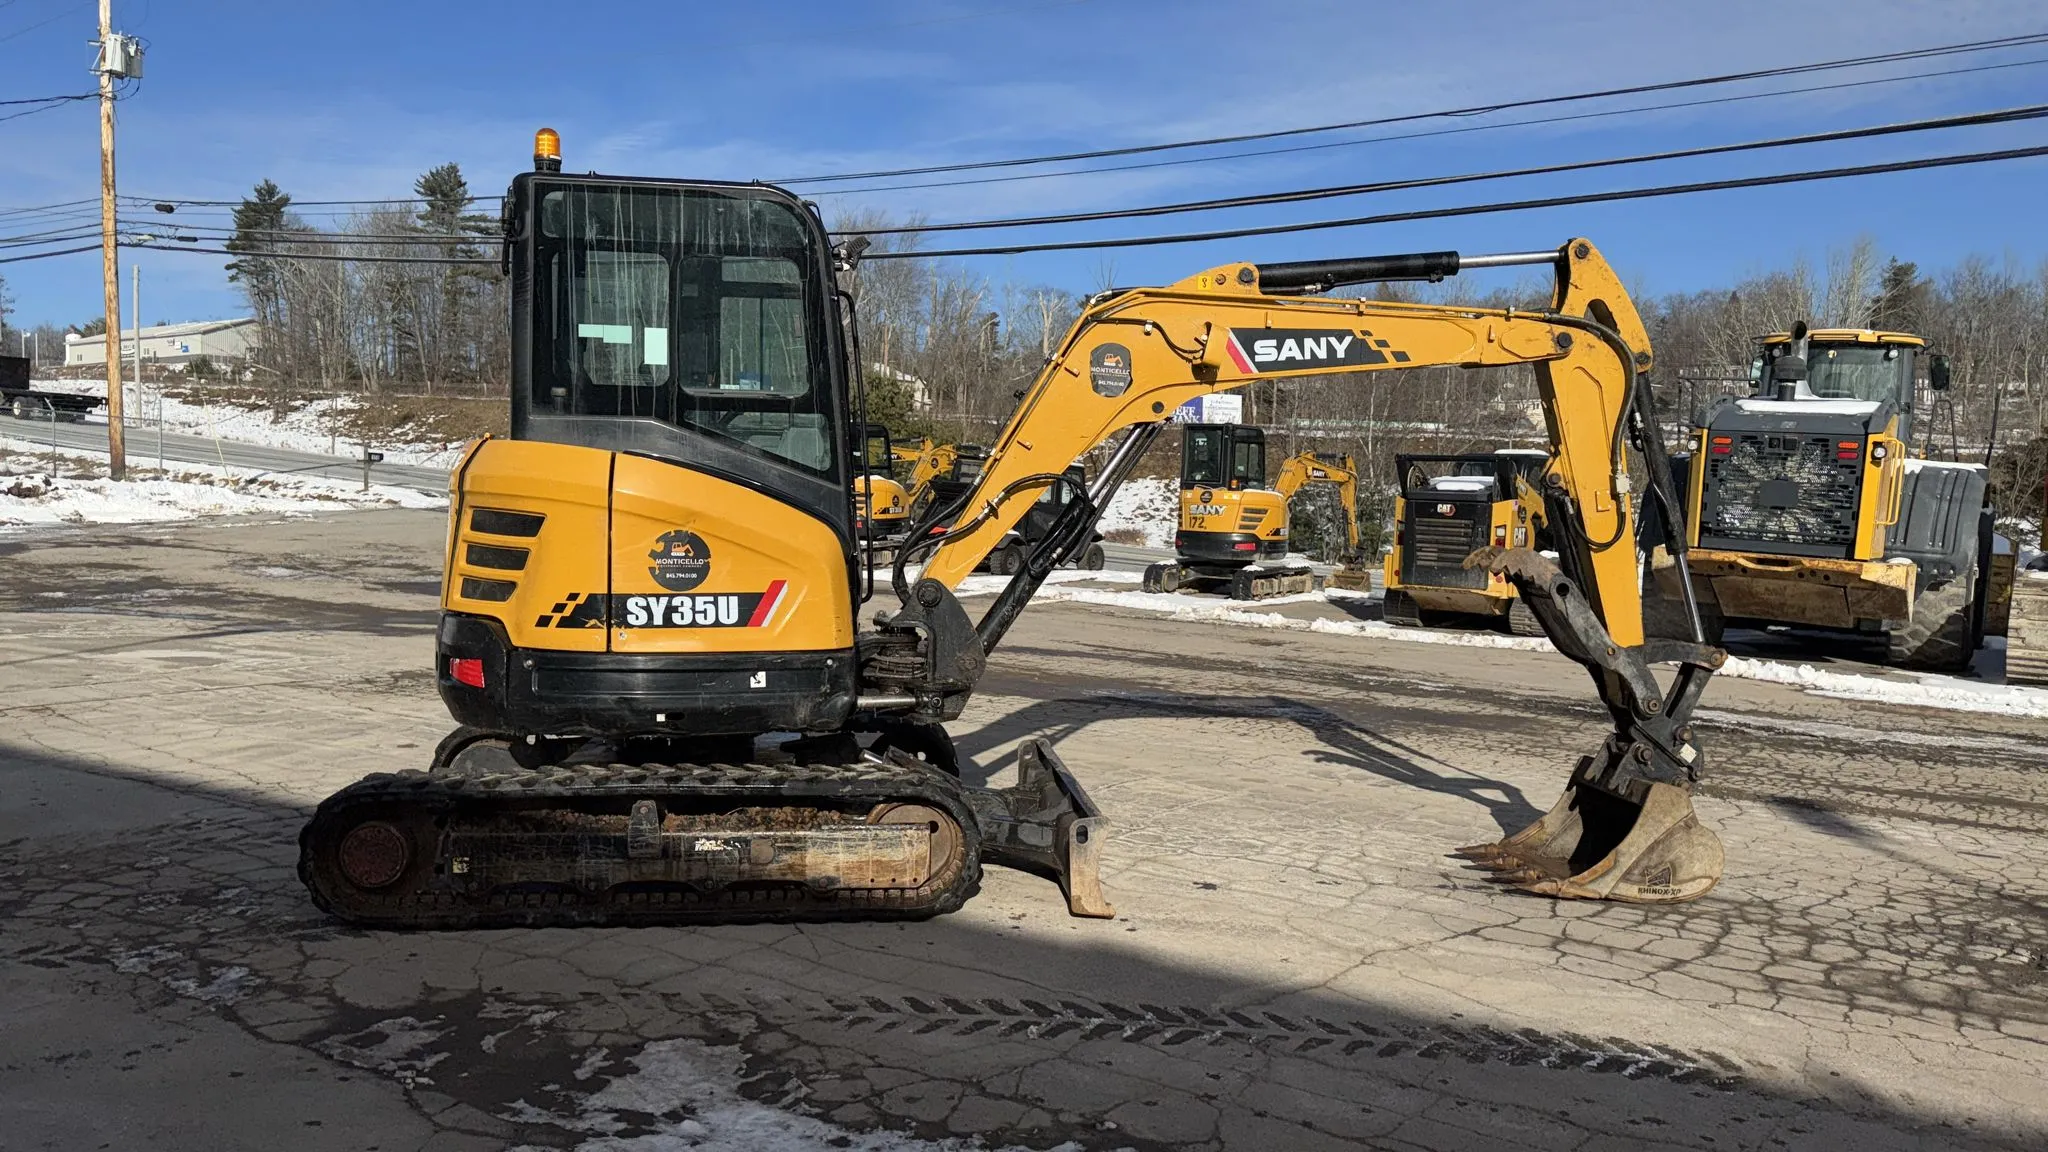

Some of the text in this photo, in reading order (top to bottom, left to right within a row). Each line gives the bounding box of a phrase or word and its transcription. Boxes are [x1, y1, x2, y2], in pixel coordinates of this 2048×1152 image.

[1254, 336, 1353, 362] SANY
[1190, 505, 1227, 516] SANY
[1437, 504, 1450, 513] CAT
[1514, 527, 1526, 547] CAT
[626, 596, 739, 626] SY35U
[1638, 888, 1681, 896] RHINOX-XP
